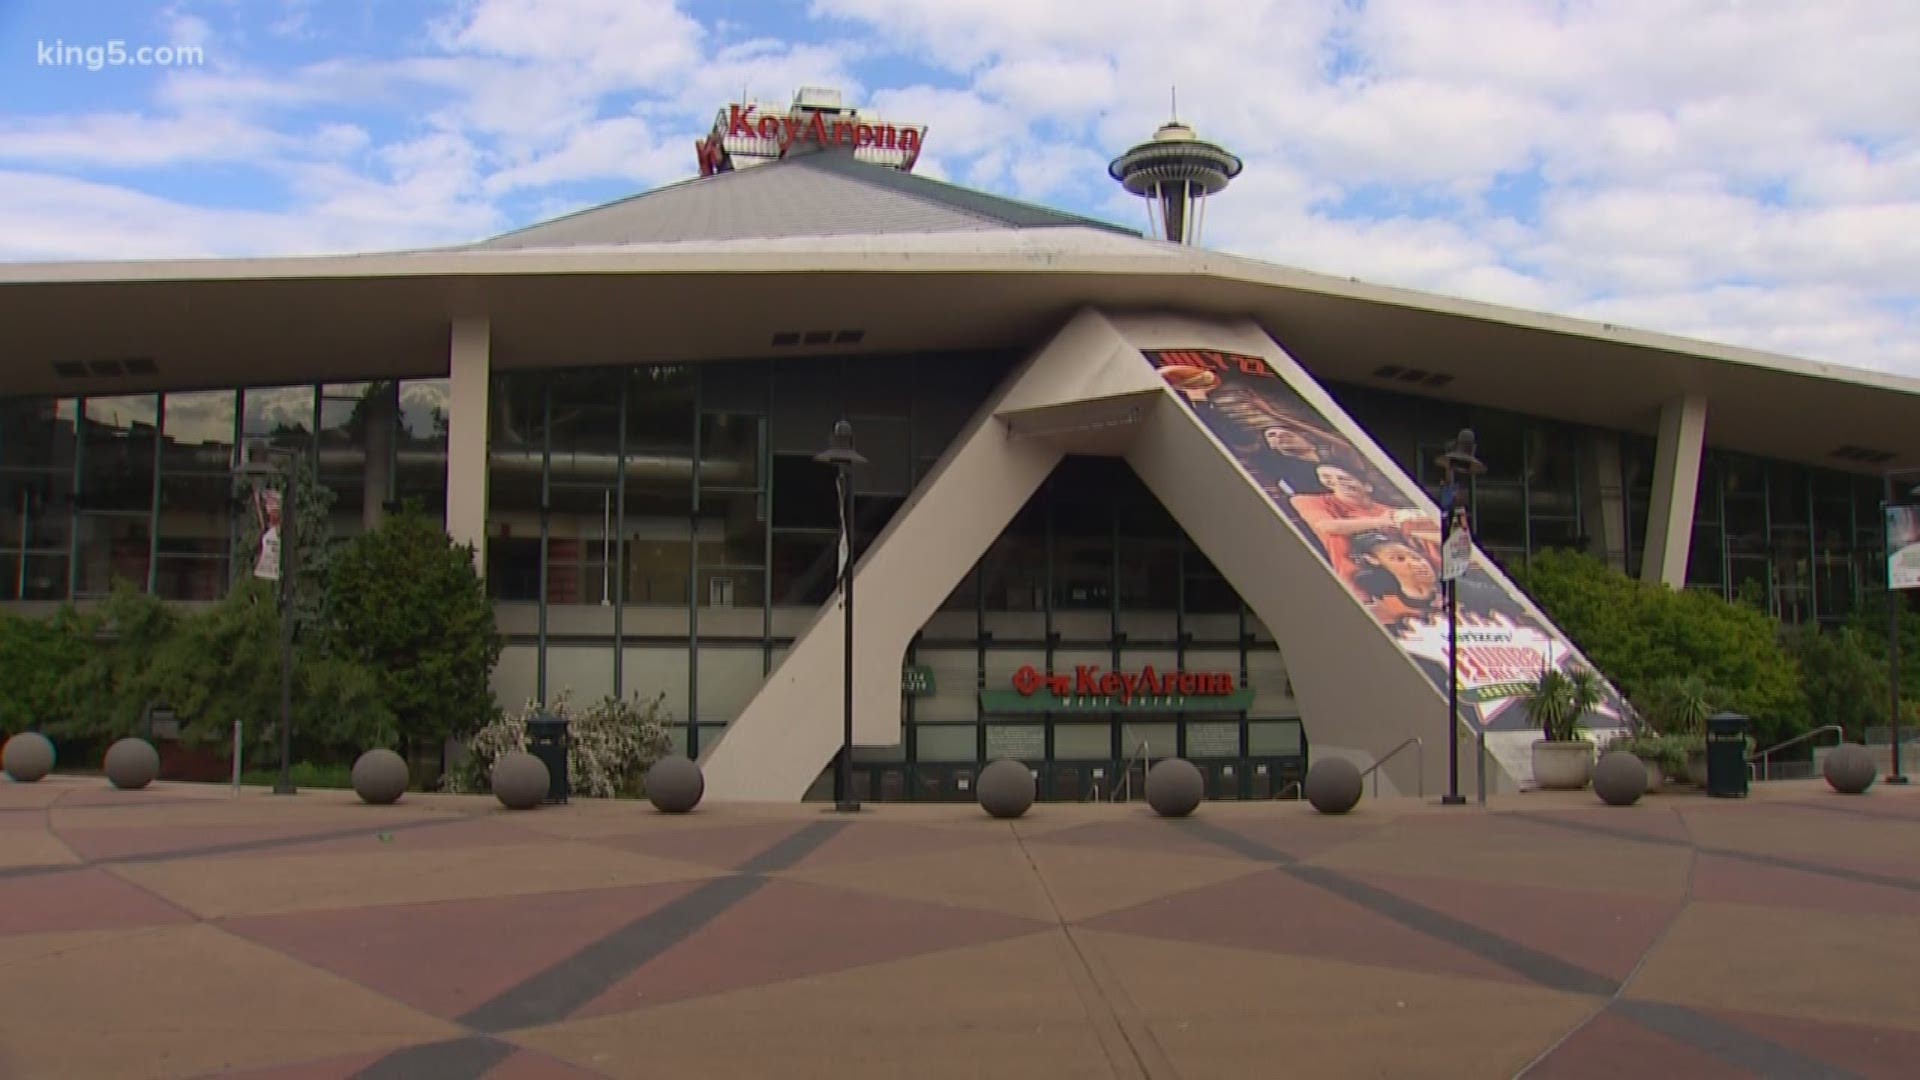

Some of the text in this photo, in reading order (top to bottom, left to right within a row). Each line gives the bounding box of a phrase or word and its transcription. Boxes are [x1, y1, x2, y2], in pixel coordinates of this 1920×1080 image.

[728, 102, 921, 159] KeyArena
[1158, 351, 1230, 371] JULY
[1075, 664, 1235, 704] KeyArena
[1061, 696, 1111, 707] WEST
